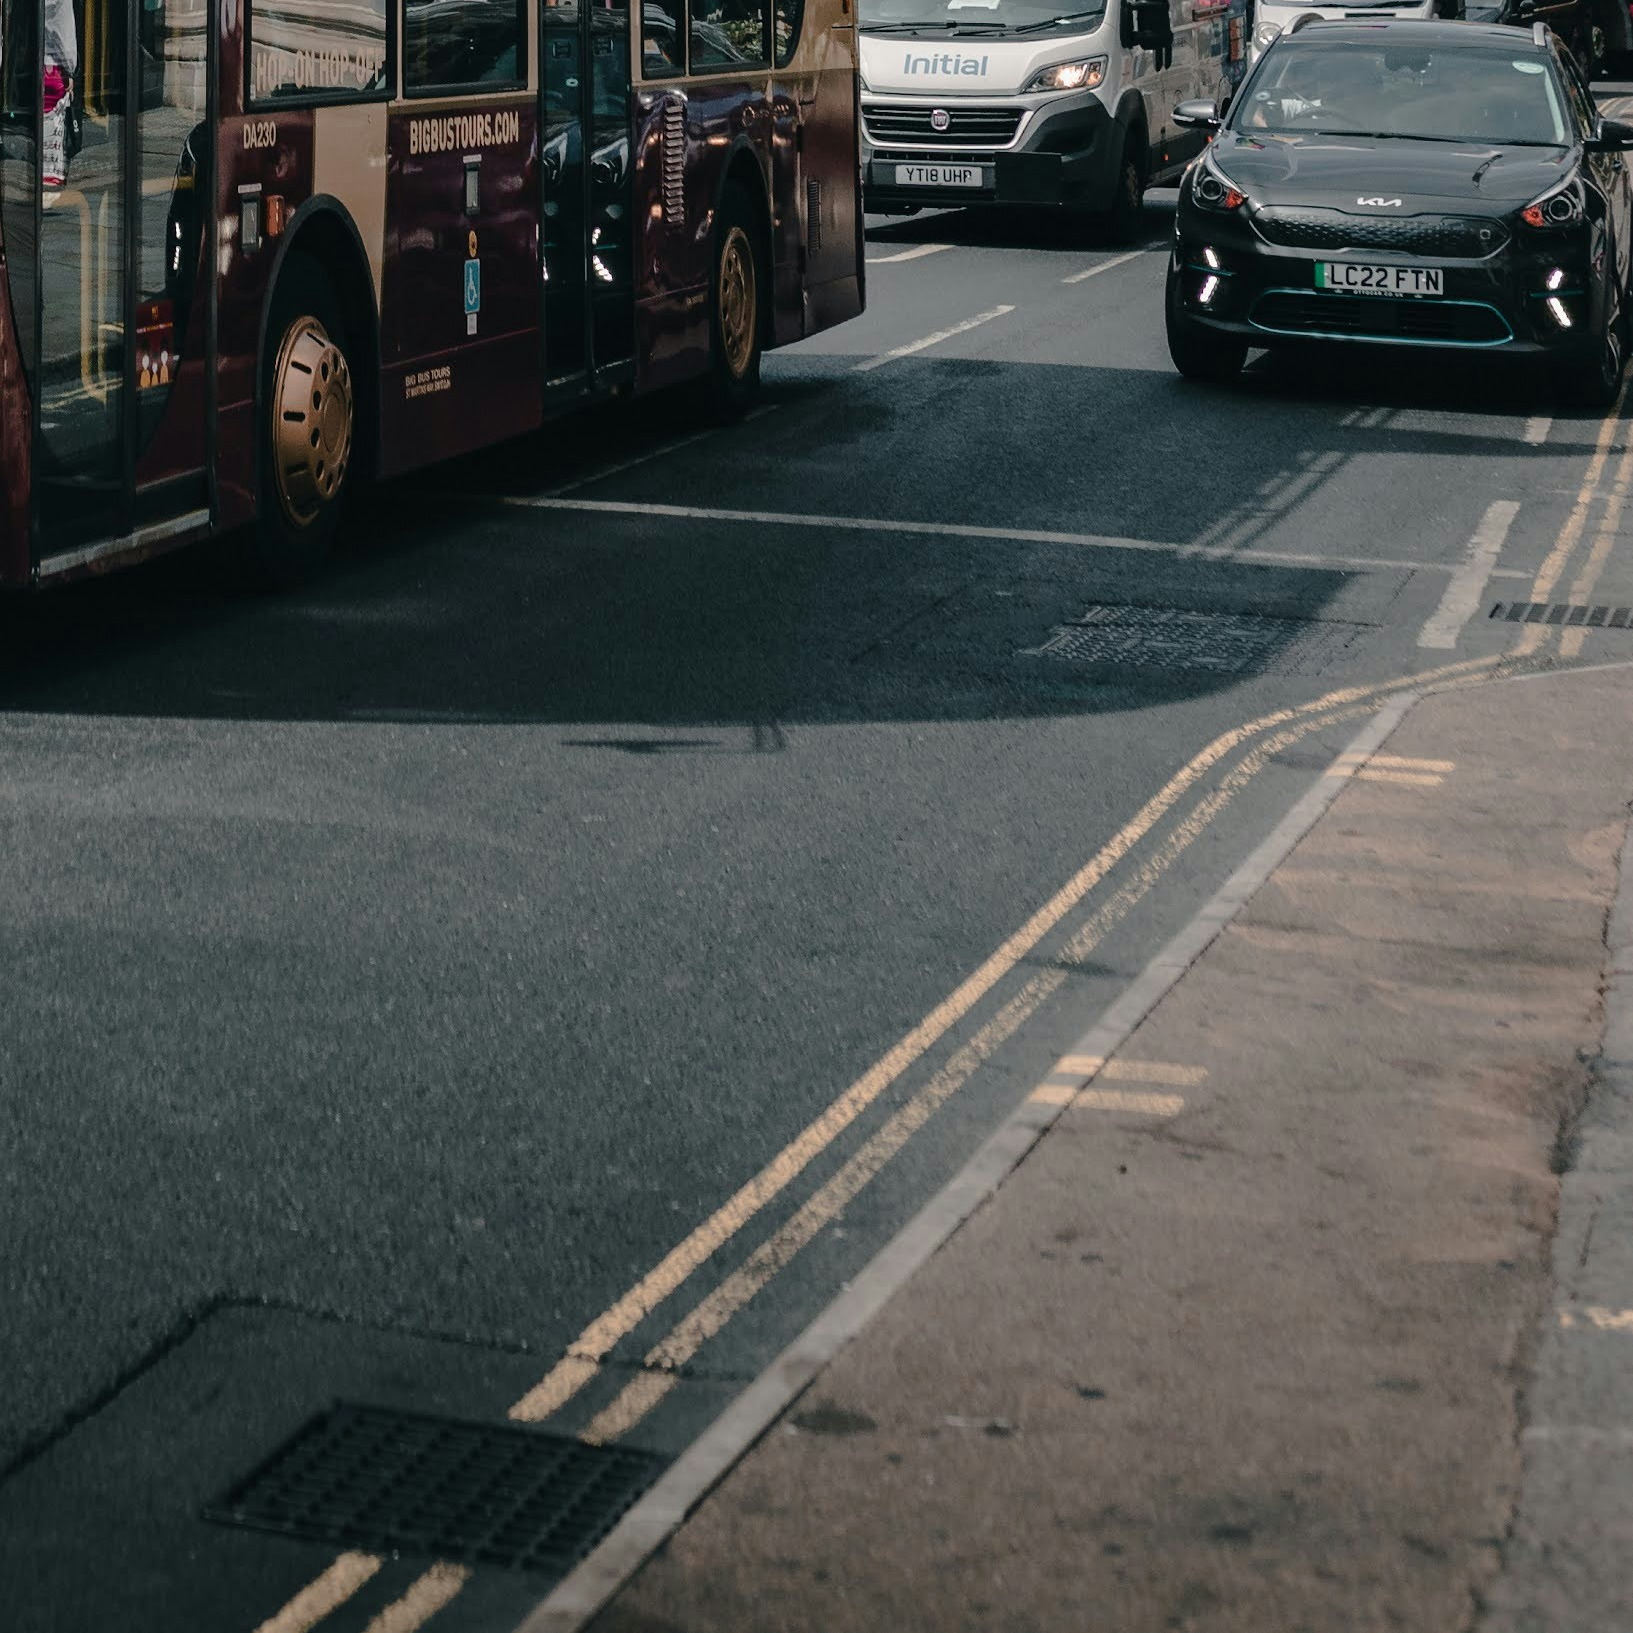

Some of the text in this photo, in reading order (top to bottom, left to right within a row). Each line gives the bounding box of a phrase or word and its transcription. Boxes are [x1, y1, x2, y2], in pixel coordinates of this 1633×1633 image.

[904, 54, 989, 76] Initial
[243, 121, 276, 150] DA230
[410, 111, 519, 155] BIGBUSTOURS.COM
[906, 167, 939, 182] YT18
[1330, 264, 1439, 291] LC22 FTN
[405, 366, 451, 387] BIG BUS TOURS
